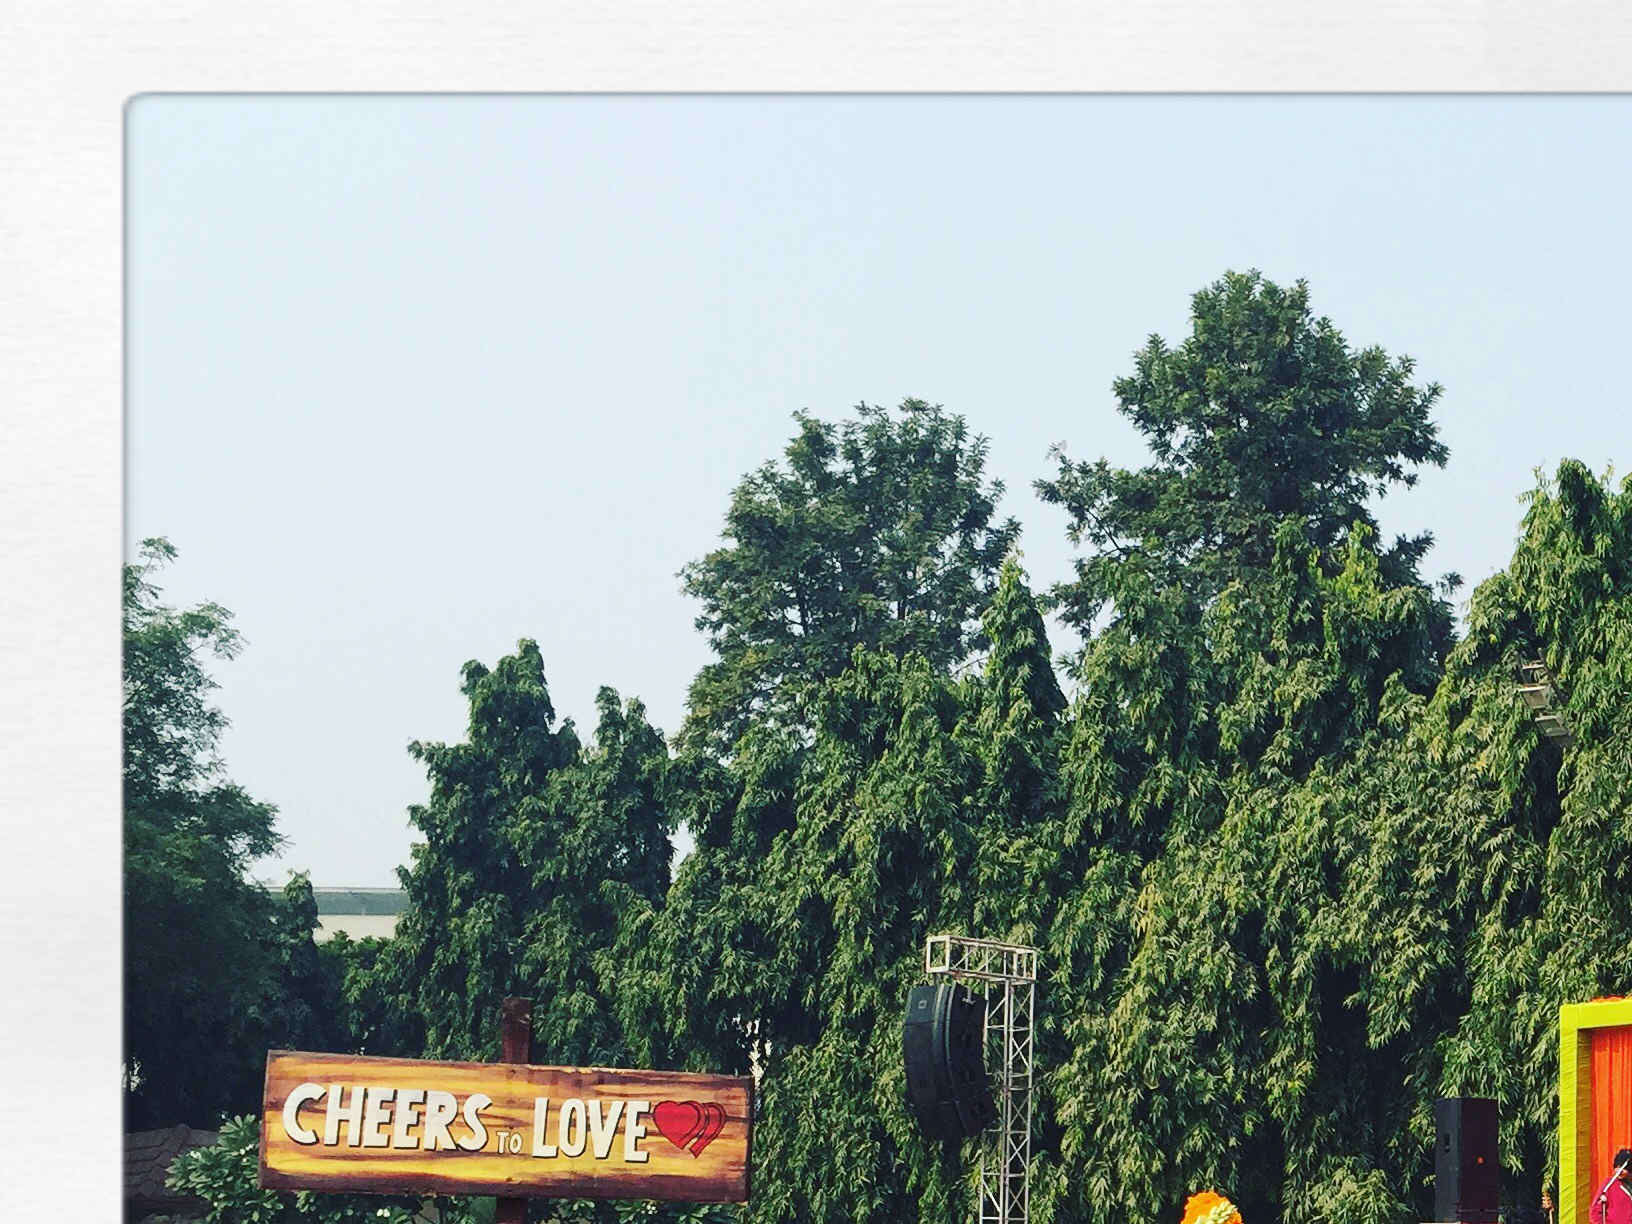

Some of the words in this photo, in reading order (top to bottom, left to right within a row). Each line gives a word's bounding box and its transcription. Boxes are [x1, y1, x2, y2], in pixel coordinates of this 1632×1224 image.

[282, 1082, 492, 1152] CHEERS
[496, 1131, 522, 1155] TO
[532, 1097, 650, 1162] LOVE
